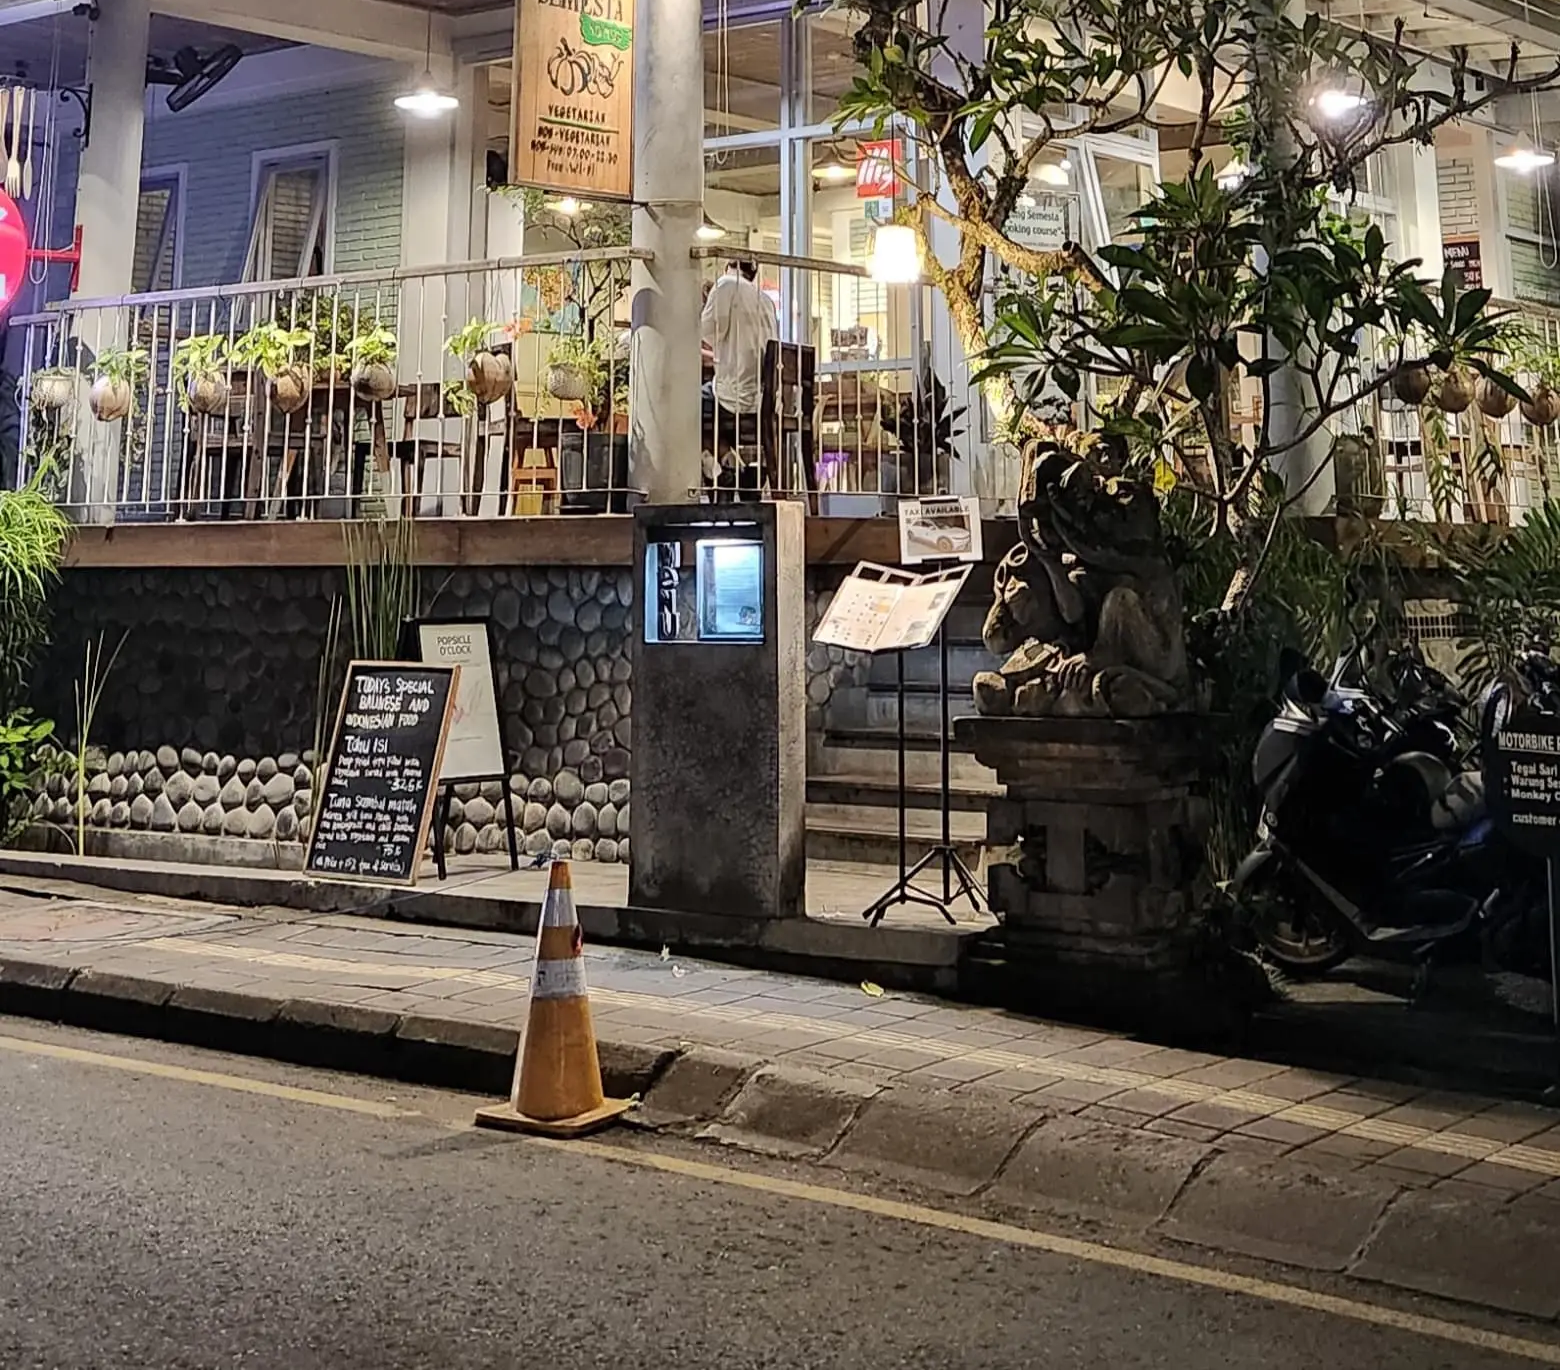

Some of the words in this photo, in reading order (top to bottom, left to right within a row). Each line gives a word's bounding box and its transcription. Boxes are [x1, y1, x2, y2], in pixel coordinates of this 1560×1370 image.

[548, 103, 606, 123] VEGETARIAN
[437, 635, 471, 646] POPSICLE
[440, 645, 472, 656] O'CLOCK
[396, 676, 435, 698] SPECIAL
[359, 694, 402, 712] BALINESE
[408, 698, 430, 713] AND
[398, 713, 419, 728] FOOD
[1498, 732, 1555, 751] MOTORBIKE
[1511, 761, 1537, 777] Tegal
[1539, 762, 1558, 777] Sari
[1511, 774, 1545, 790] Warung
[1511, 788, 1552, 803] Monkey
[1512, 812, 1557, 826] customer
